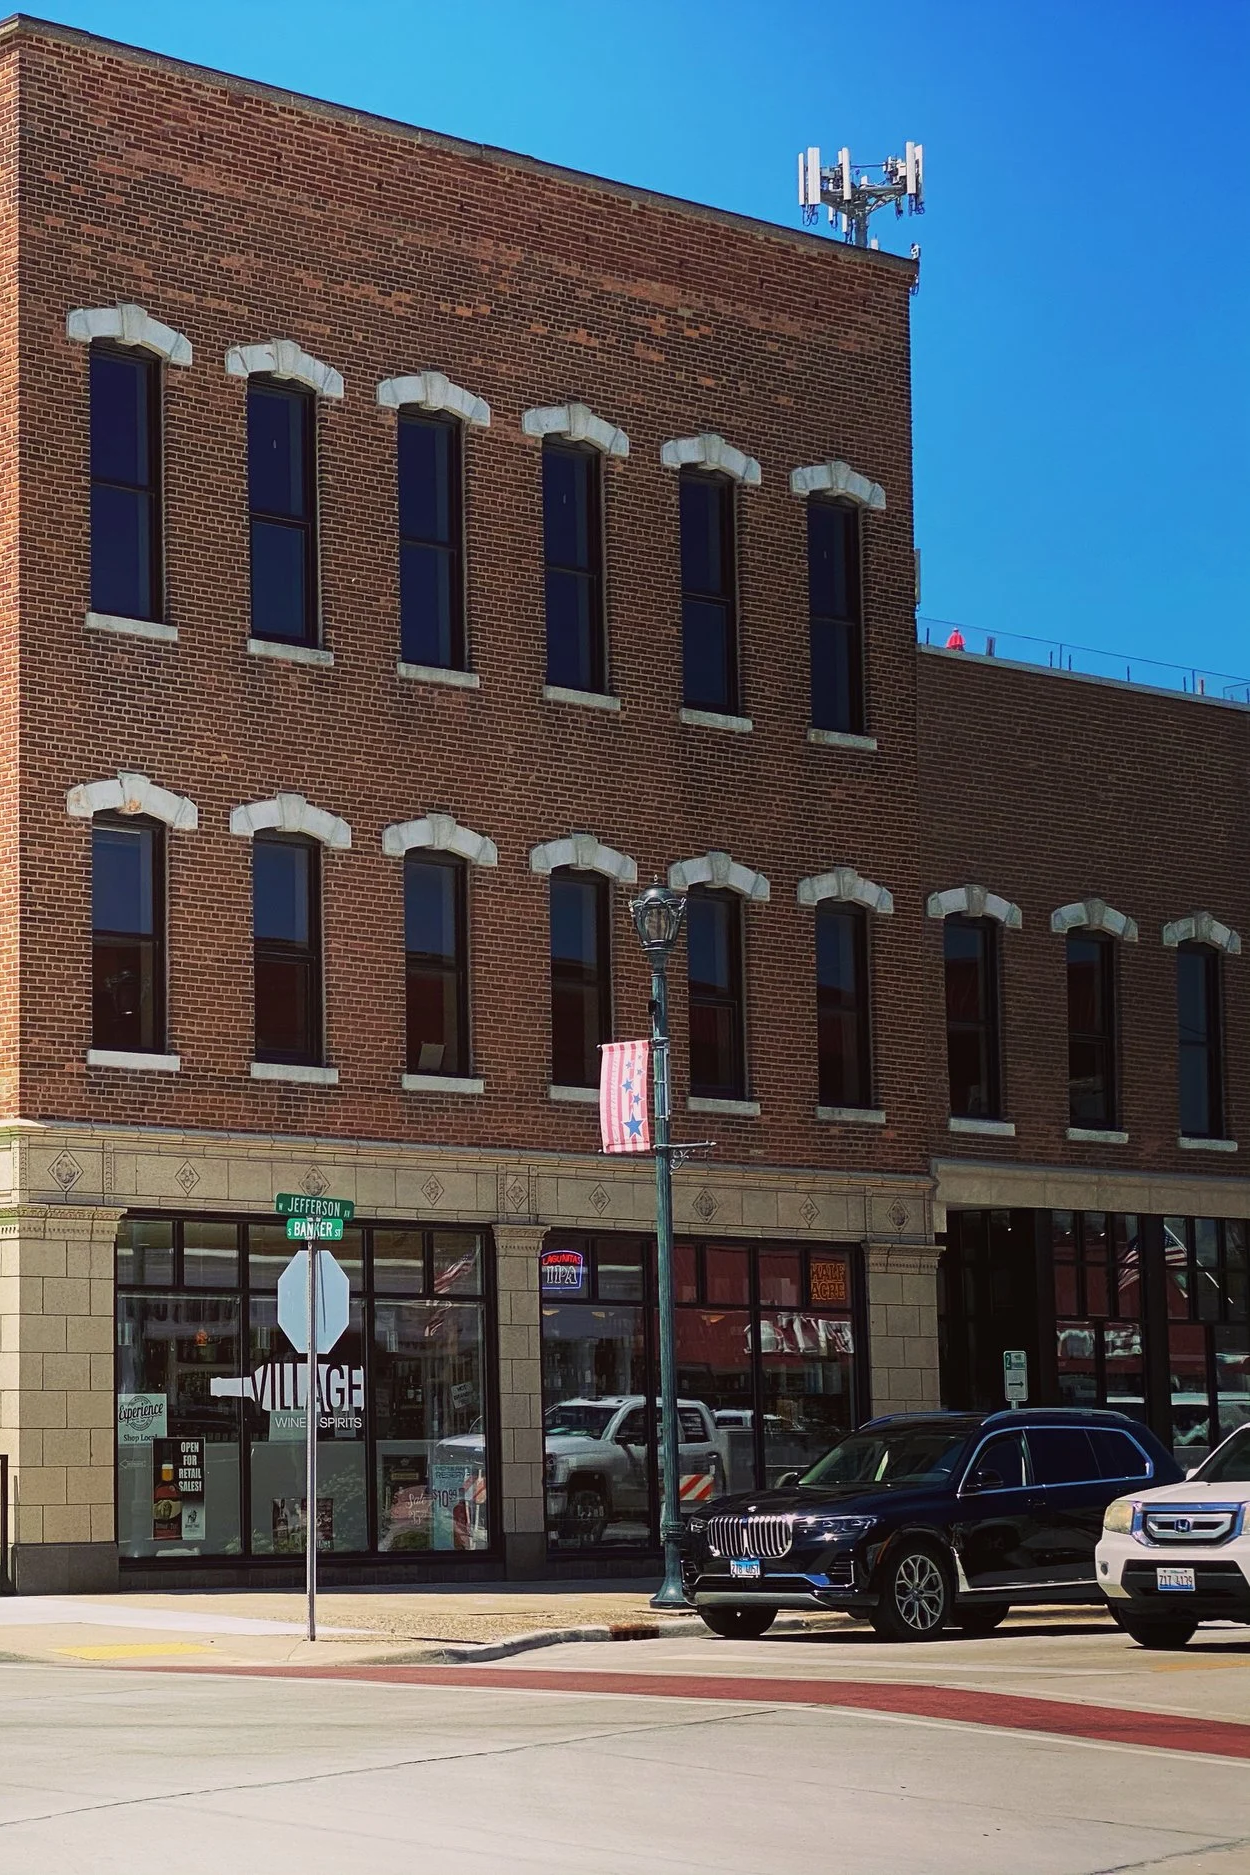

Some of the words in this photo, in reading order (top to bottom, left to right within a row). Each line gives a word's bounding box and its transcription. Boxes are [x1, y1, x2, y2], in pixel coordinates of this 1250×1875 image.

[287, 1196, 341, 1217] JEFFERSON
[287, 1228, 292, 1237] S
[293, 1221, 333, 1238] BANKER
[334, 1228, 342, 1237] ST
[543, 1254, 581, 1266] LAGUNITAS
[546, 1265, 578, 1285] IPA
[810, 1263, 846, 1281] HALF
[810, 1281, 846, 1300] ACRE
[250, 1363, 365, 1412] VILLAGE
[119, 1403, 164, 1427] Experience
[275, 1416, 306, 1428] WINE
[319, 1416, 362, 1429] SPIRITS
[123, 1434, 140, 1442] Shop
[141, 1433, 158, 1441] Local
[180, 1441, 200, 1453] OPEN
[182, 1454, 198, 1466] FOR
[178, 1467, 202, 1479] RETAIL
[178, 1480, 202, 1492] SALES!
